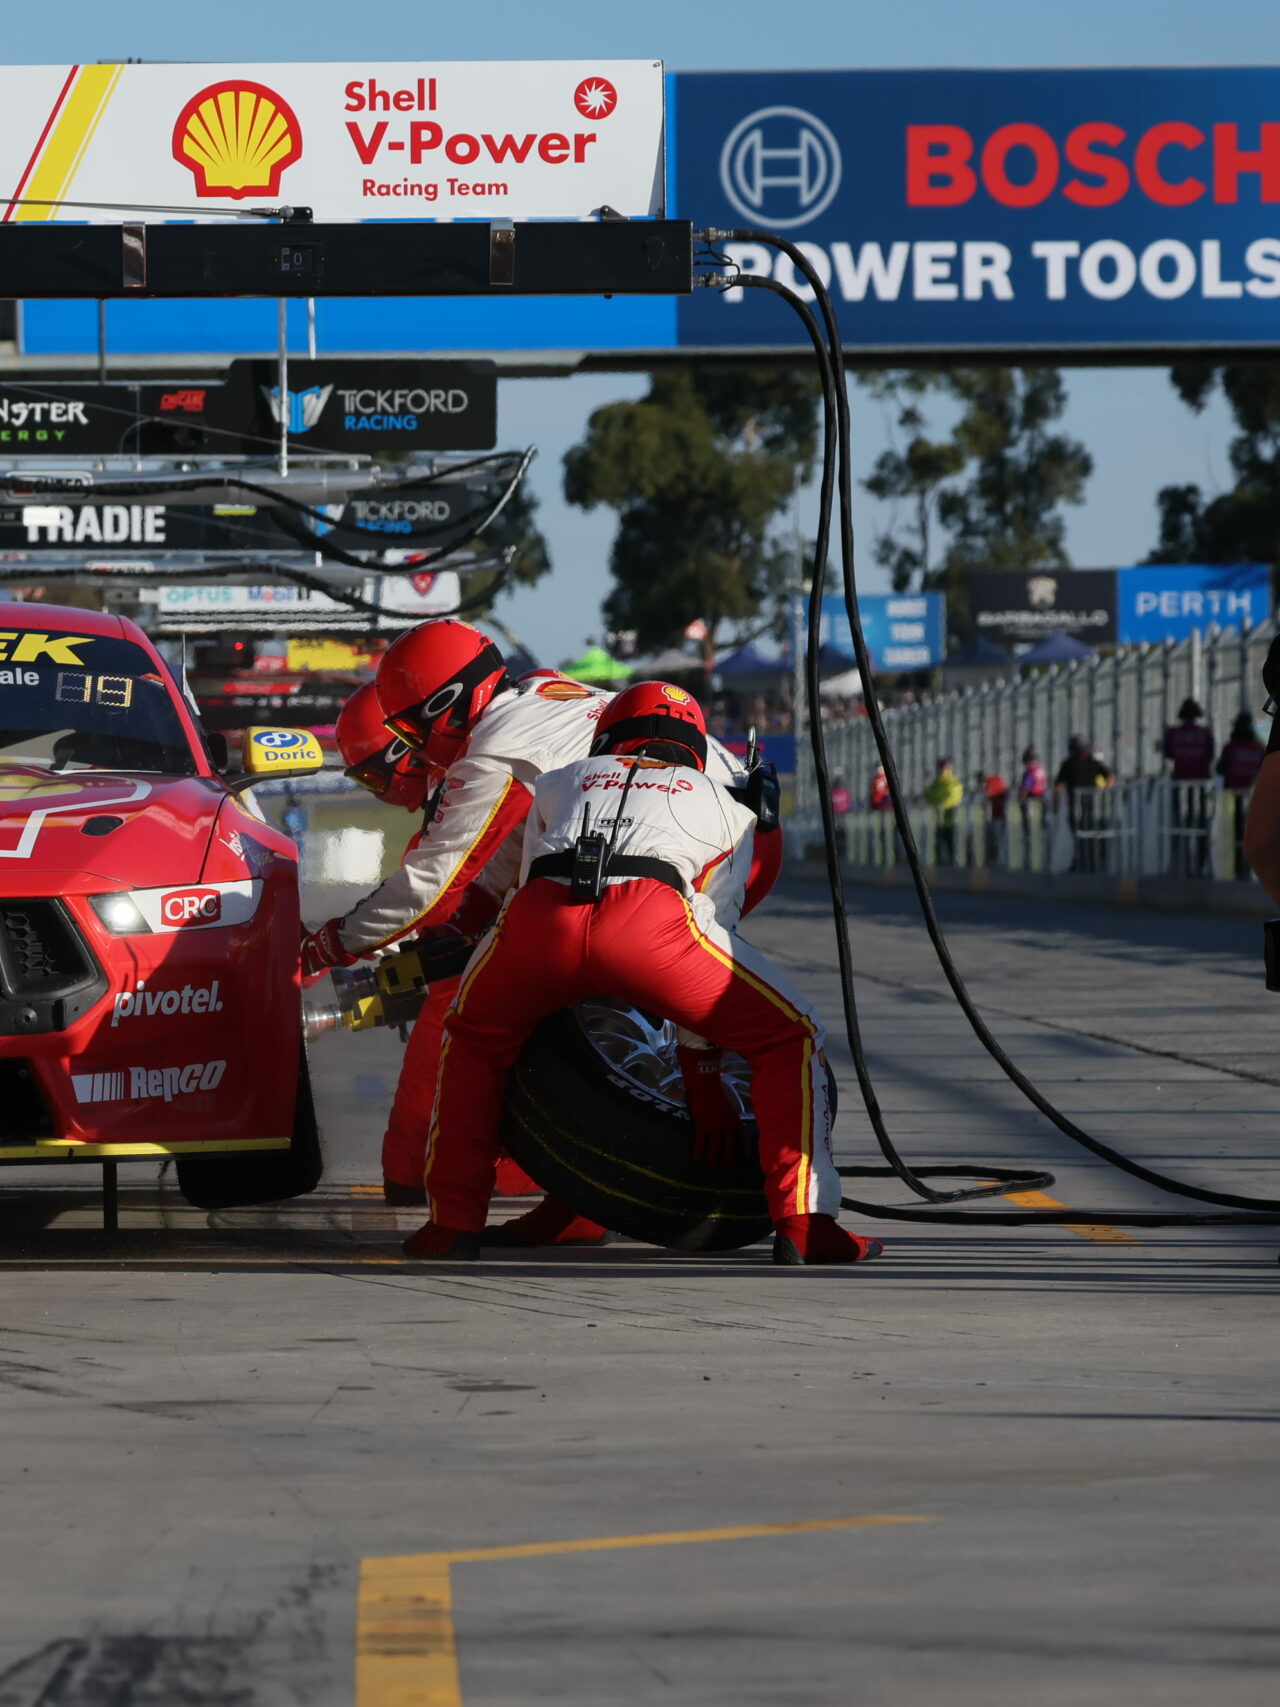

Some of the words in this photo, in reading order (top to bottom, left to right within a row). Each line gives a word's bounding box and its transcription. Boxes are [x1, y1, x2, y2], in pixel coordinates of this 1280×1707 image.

[344, 78, 437, 112] Shell
[344, 121, 597, 164] V-Power
[906, 121, 1280, 208] BOSCH
[363, 178, 438, 201] Racing
[446, 178, 508, 197] Team
[721, 239, 1014, 302] POWER
[1032, 238, 1280, 299] TOOLS
[336, 389, 468, 414] TICKFORD
[344, 414, 417, 431] RACING
[350, 501, 451, 520] TICKFORD
[26, 505, 166, 543] TRADIE
[166, 586, 233, 603] OPTUS
[1135, 591, 1252, 617] PERTH
[264, 748, 316, 762] Doric
[581, 779, 682, 795] V-Power
[583, 771, 621, 781] Shell
[163, 896, 219, 920] CRC
[111, 979, 224, 1028] pivotel.
[129, 1059, 227, 1103] Repco
